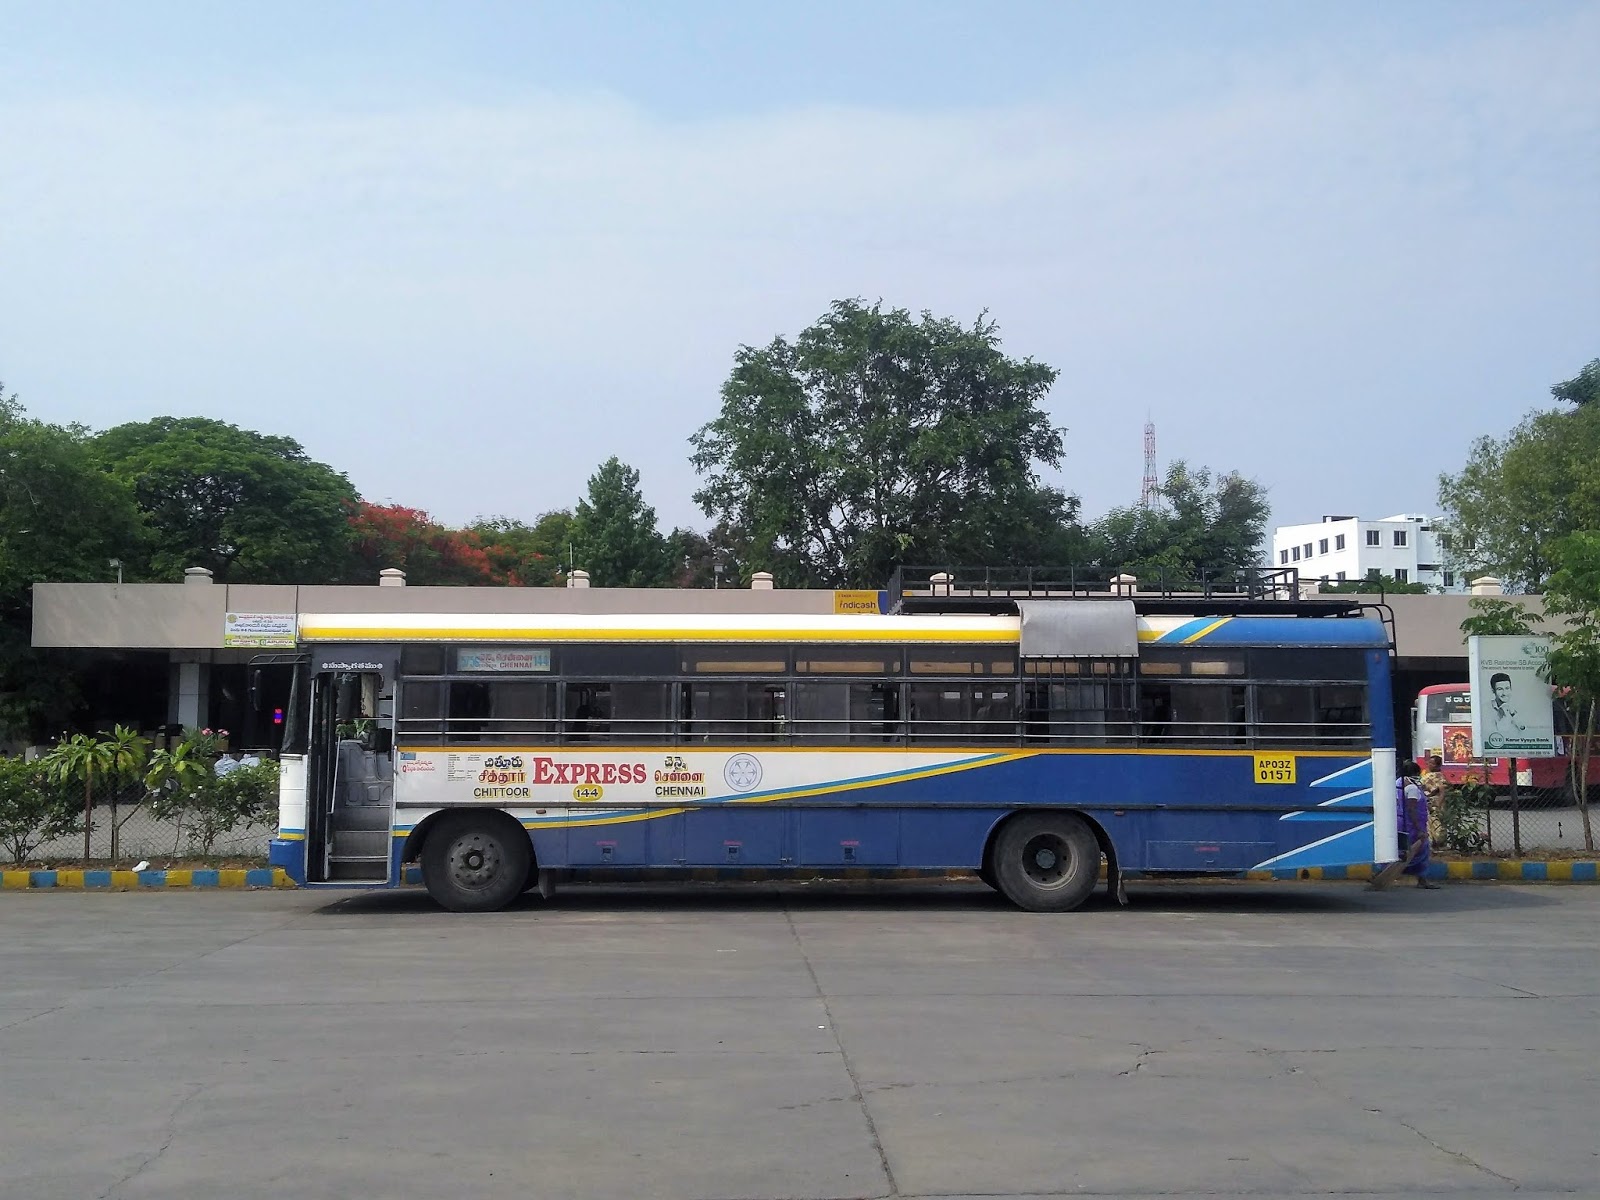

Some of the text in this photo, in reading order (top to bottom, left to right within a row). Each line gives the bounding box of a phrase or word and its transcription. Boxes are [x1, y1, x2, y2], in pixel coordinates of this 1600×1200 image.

[839, 600, 876, 609] indicash
[484, 755, 523, 770] చిత్తూరు
[1259, 760, 1291, 769] AP03Z
[654, 769, 703, 782] சென்னை
[1260, 770, 1291, 780] 0157
[473, 787, 530, 797] CHITTOOR
[576, 789, 599, 798] 144
[655, 786, 705, 796] CHENNAI
